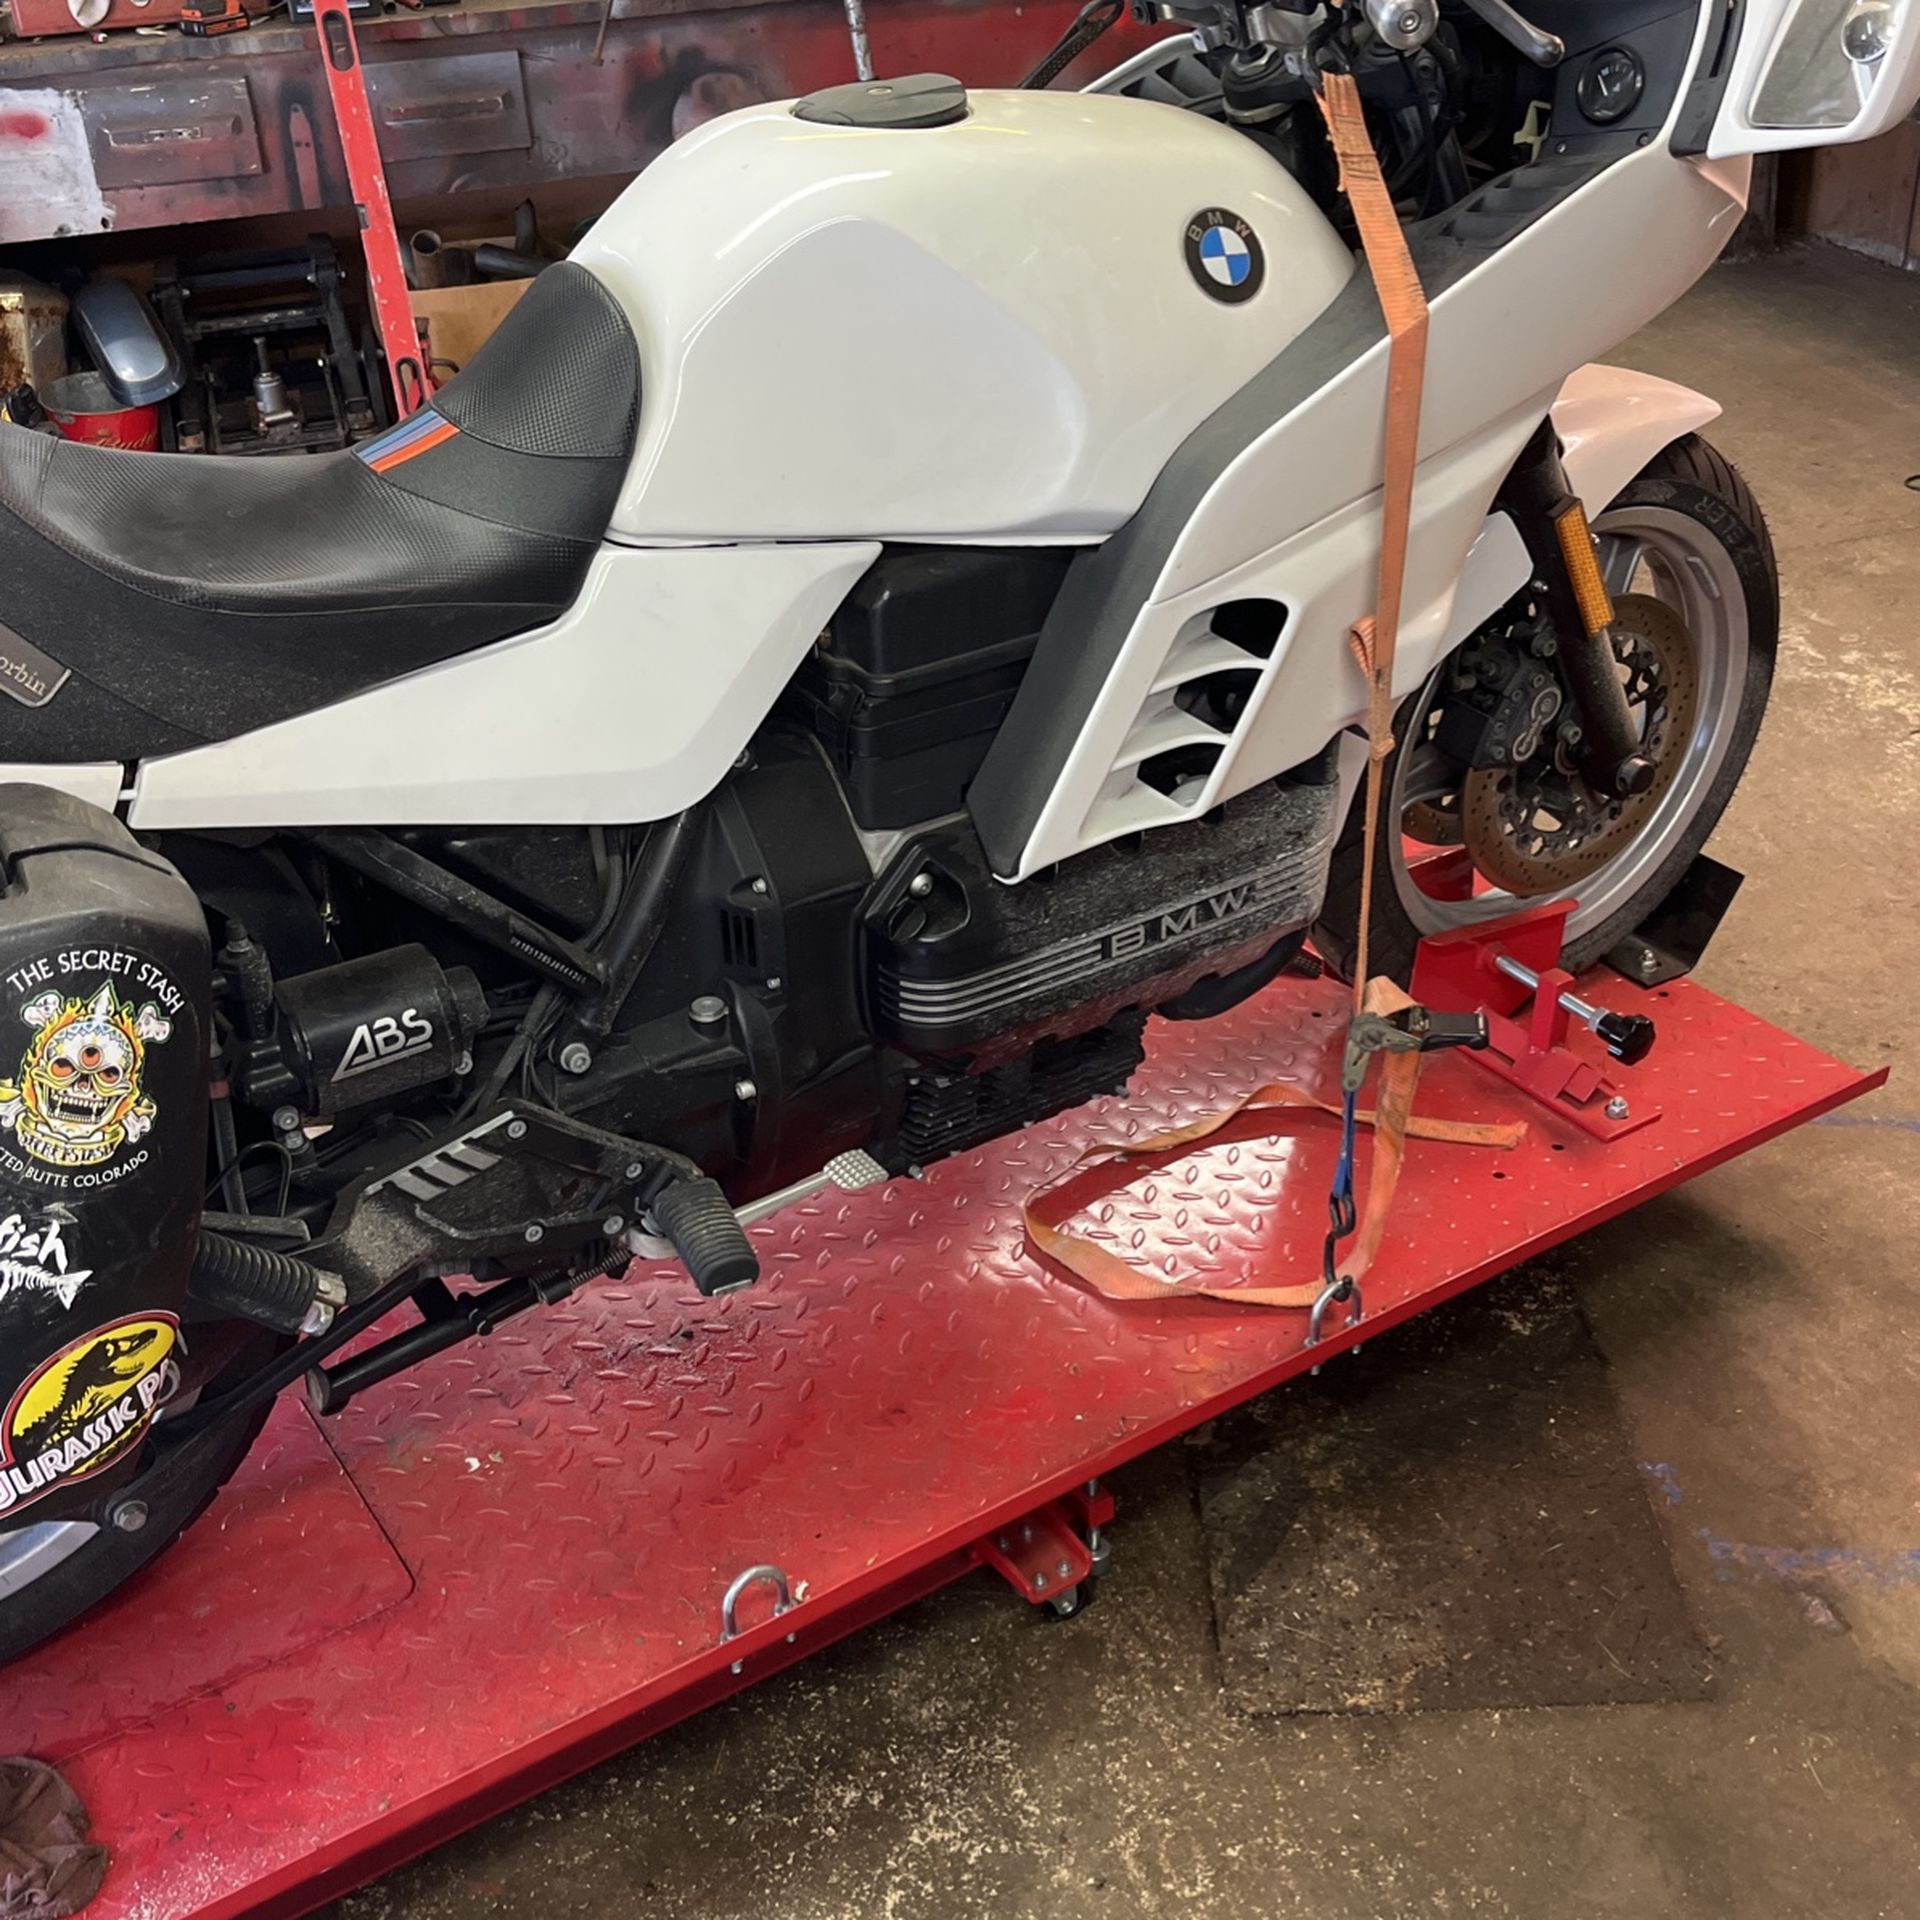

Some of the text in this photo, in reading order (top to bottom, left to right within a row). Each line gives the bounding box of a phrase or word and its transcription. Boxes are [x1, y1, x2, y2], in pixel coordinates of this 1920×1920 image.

[1187, 211, 1251, 242] BMW
[1111, 885, 1250, 958] BMW
[6, 950, 186, 1015] THE SECRET STASH
[331, 1008, 433, 1081] ABS
[0, 1147, 149, 1188] TED BUTTE COLORADO
[0, 1396, 138, 1511] JURASSIC
